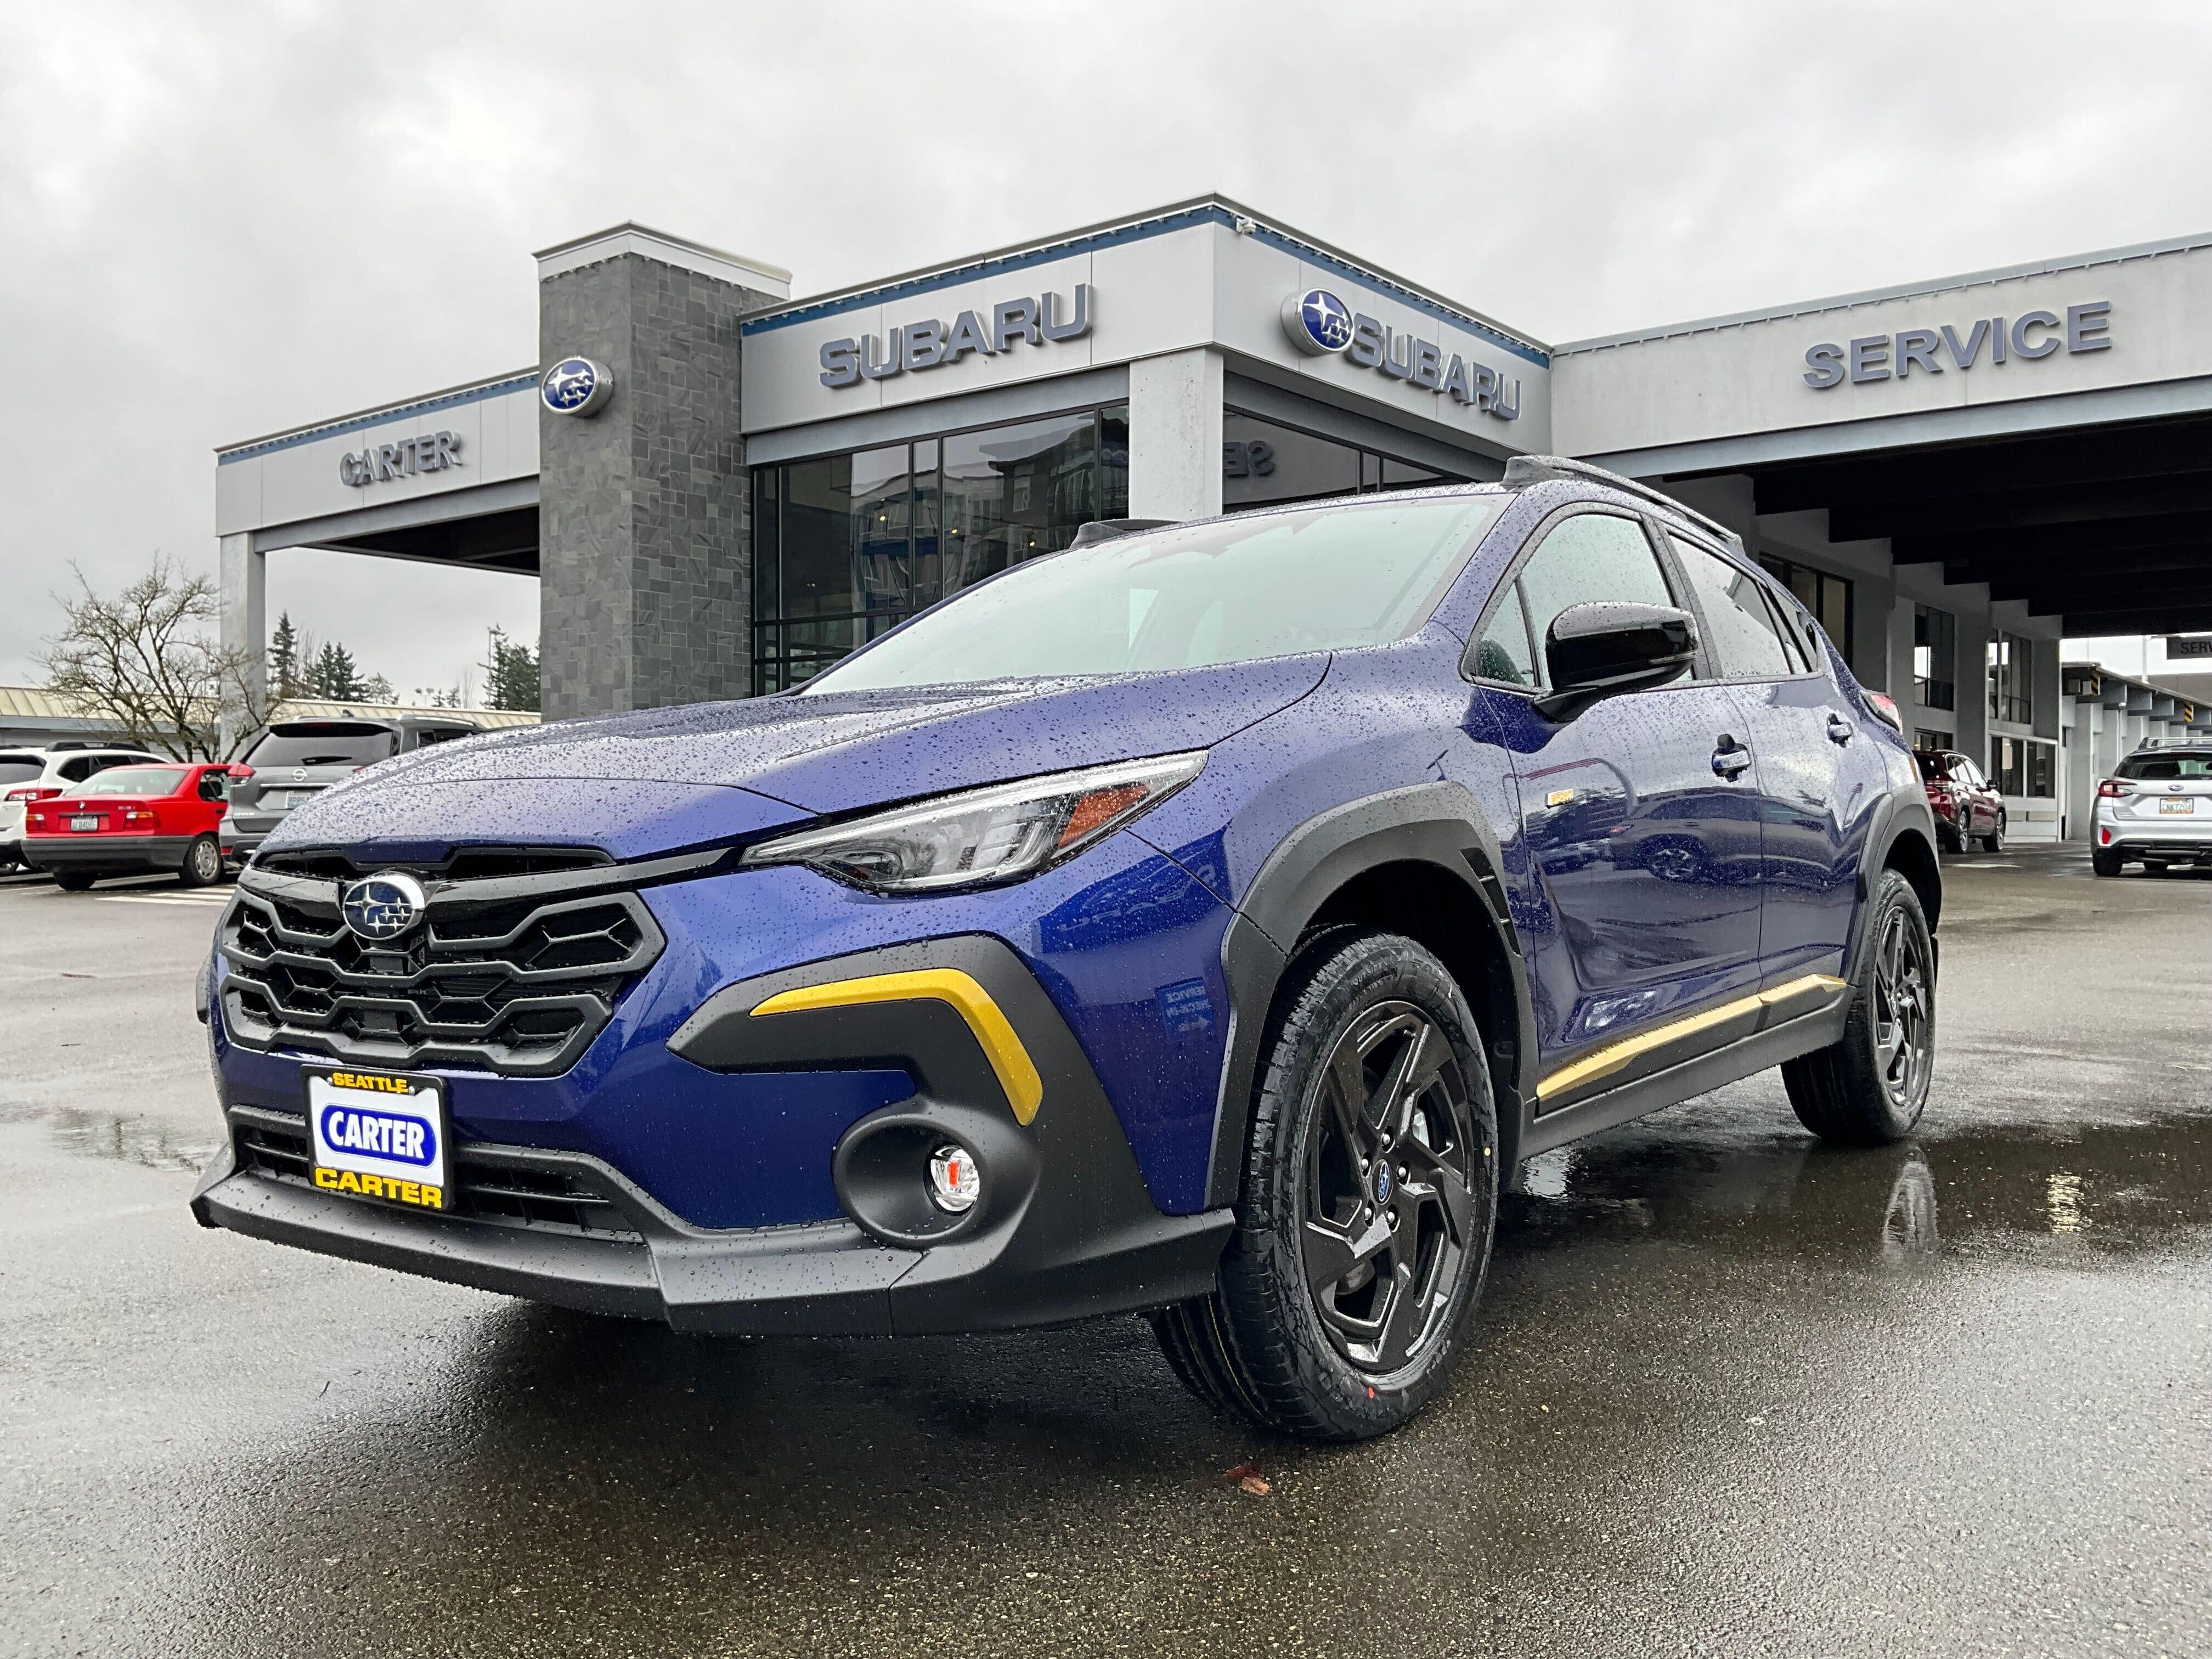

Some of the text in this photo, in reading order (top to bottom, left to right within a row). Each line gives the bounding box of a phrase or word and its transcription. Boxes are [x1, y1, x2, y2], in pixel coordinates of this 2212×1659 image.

[819, 283, 1093, 388] SUBARU
[1803, 300, 2112, 388] SERVICE
[1352, 312, 1521, 420] SUBARU
[340, 430, 462, 487] CARTER
[332, 1073, 409, 1093] SEATTLE
[329, 1111, 425, 1159] CARTER
[315, 1167, 442, 1208] CARTER
